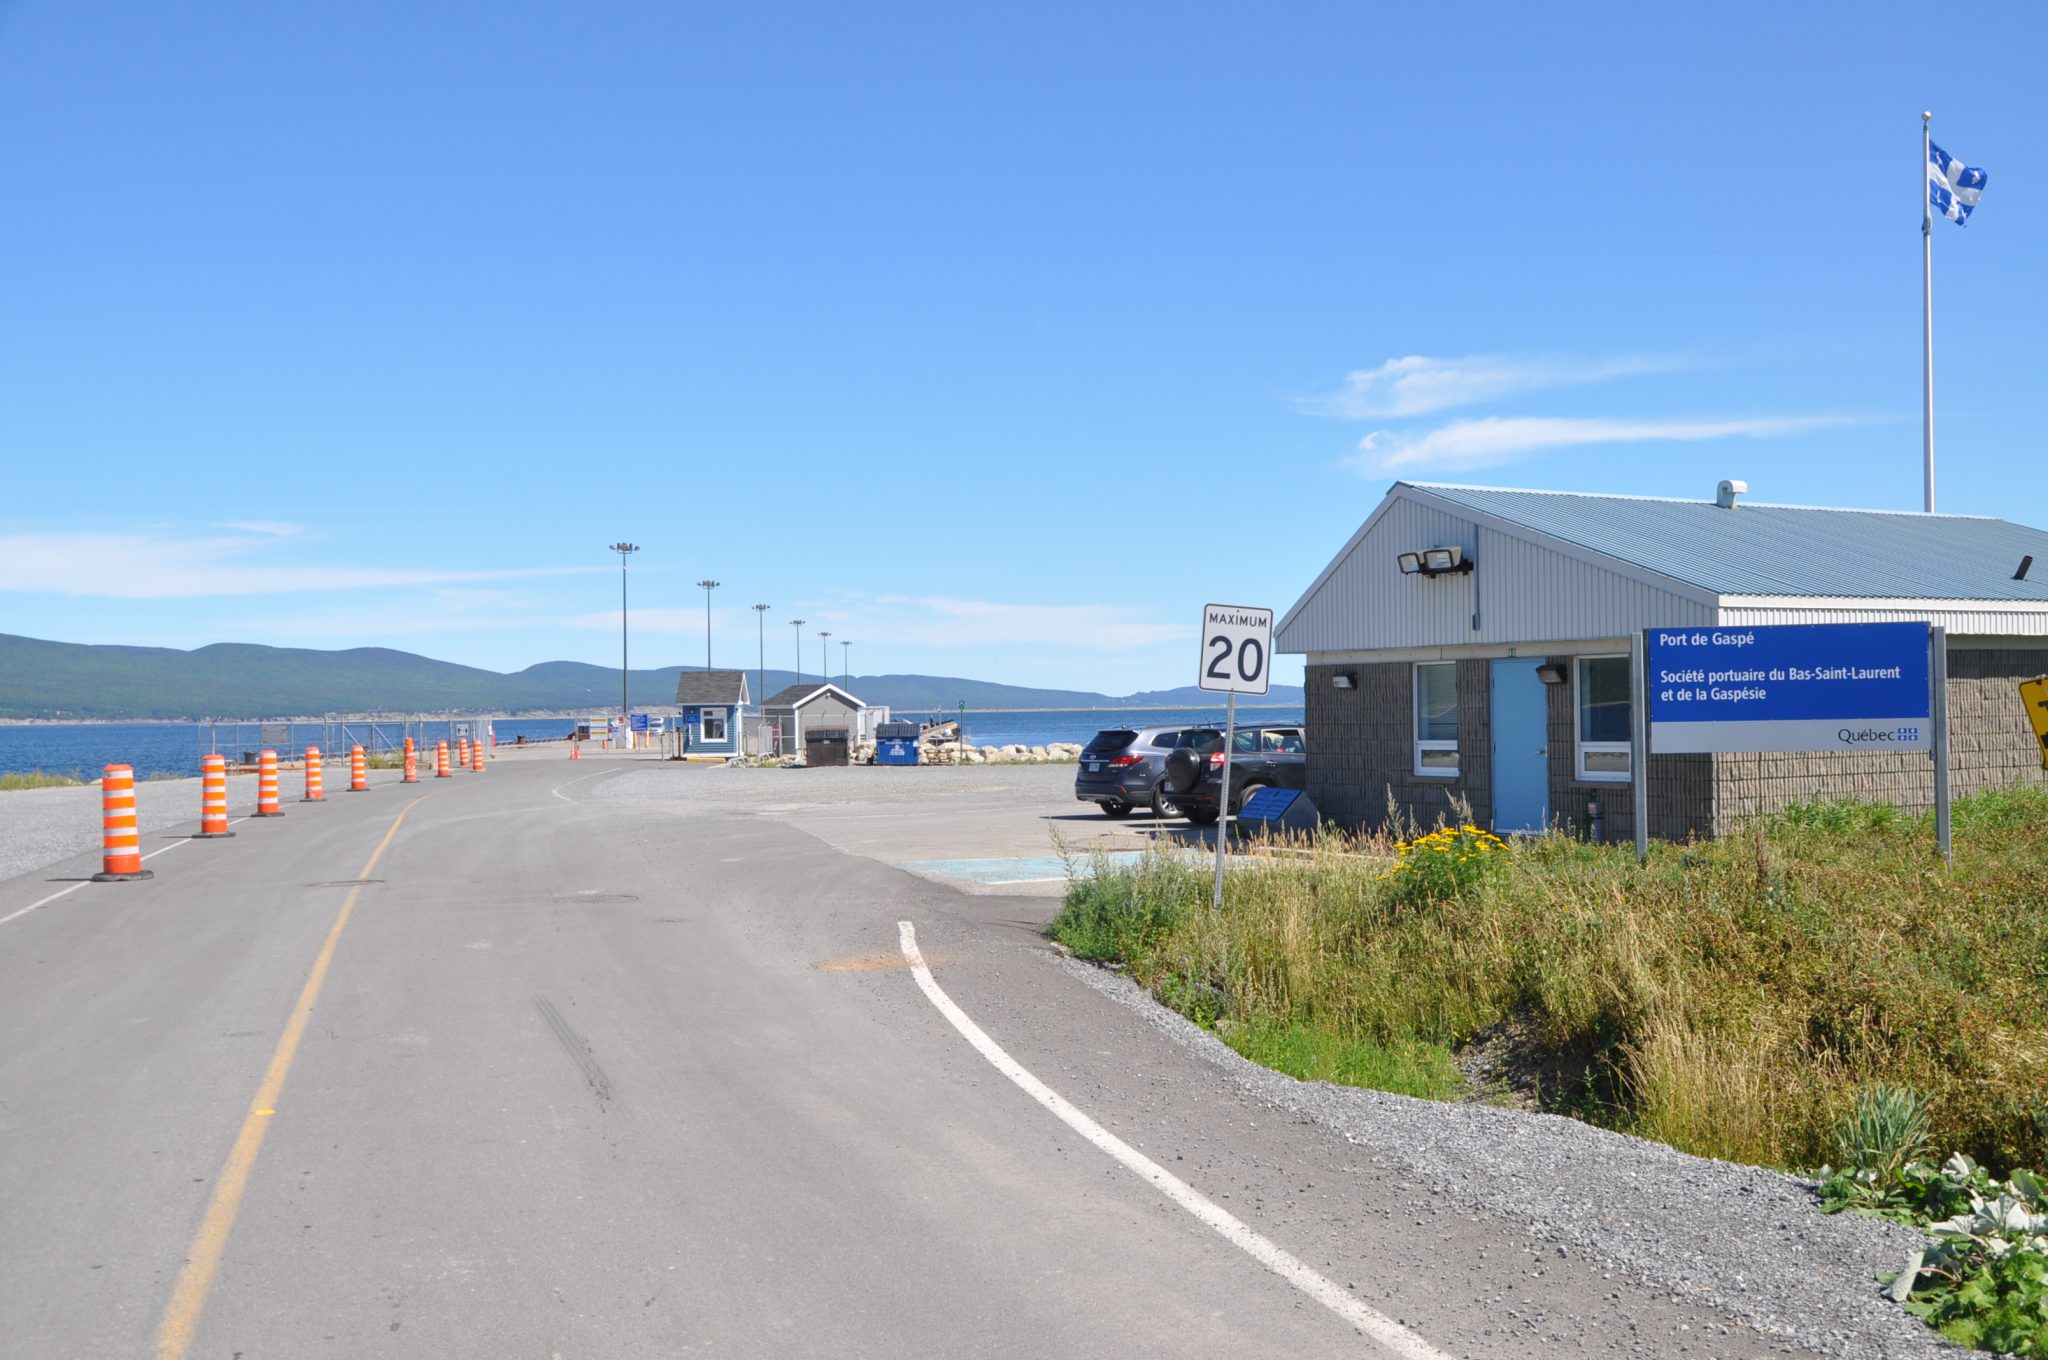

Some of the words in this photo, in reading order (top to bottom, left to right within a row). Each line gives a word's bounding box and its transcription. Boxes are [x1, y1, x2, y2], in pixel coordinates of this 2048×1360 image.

[1209, 613, 1267, 628] MAXIMUM
[1660, 633, 1687, 646] Port
[1691, 632, 1708, 646] de
[1712, 631, 1755, 648] Gaspé
[1207, 635, 1263, 682] 20
[1660, 669, 1705, 683] Société
[1708, 668, 1765, 685] portuaire
[1769, 668, 1785, 681] du
[1789, 665, 1901, 681] Bas-Saint-Laurent
[1661, 688, 1674, 701] et
[1677, 688, 1692, 701] de
[1696, 688, 1707, 701] la
[1711, 686, 1766, 703] Gaspésie
[1838, 728, 1895, 744] Québec
